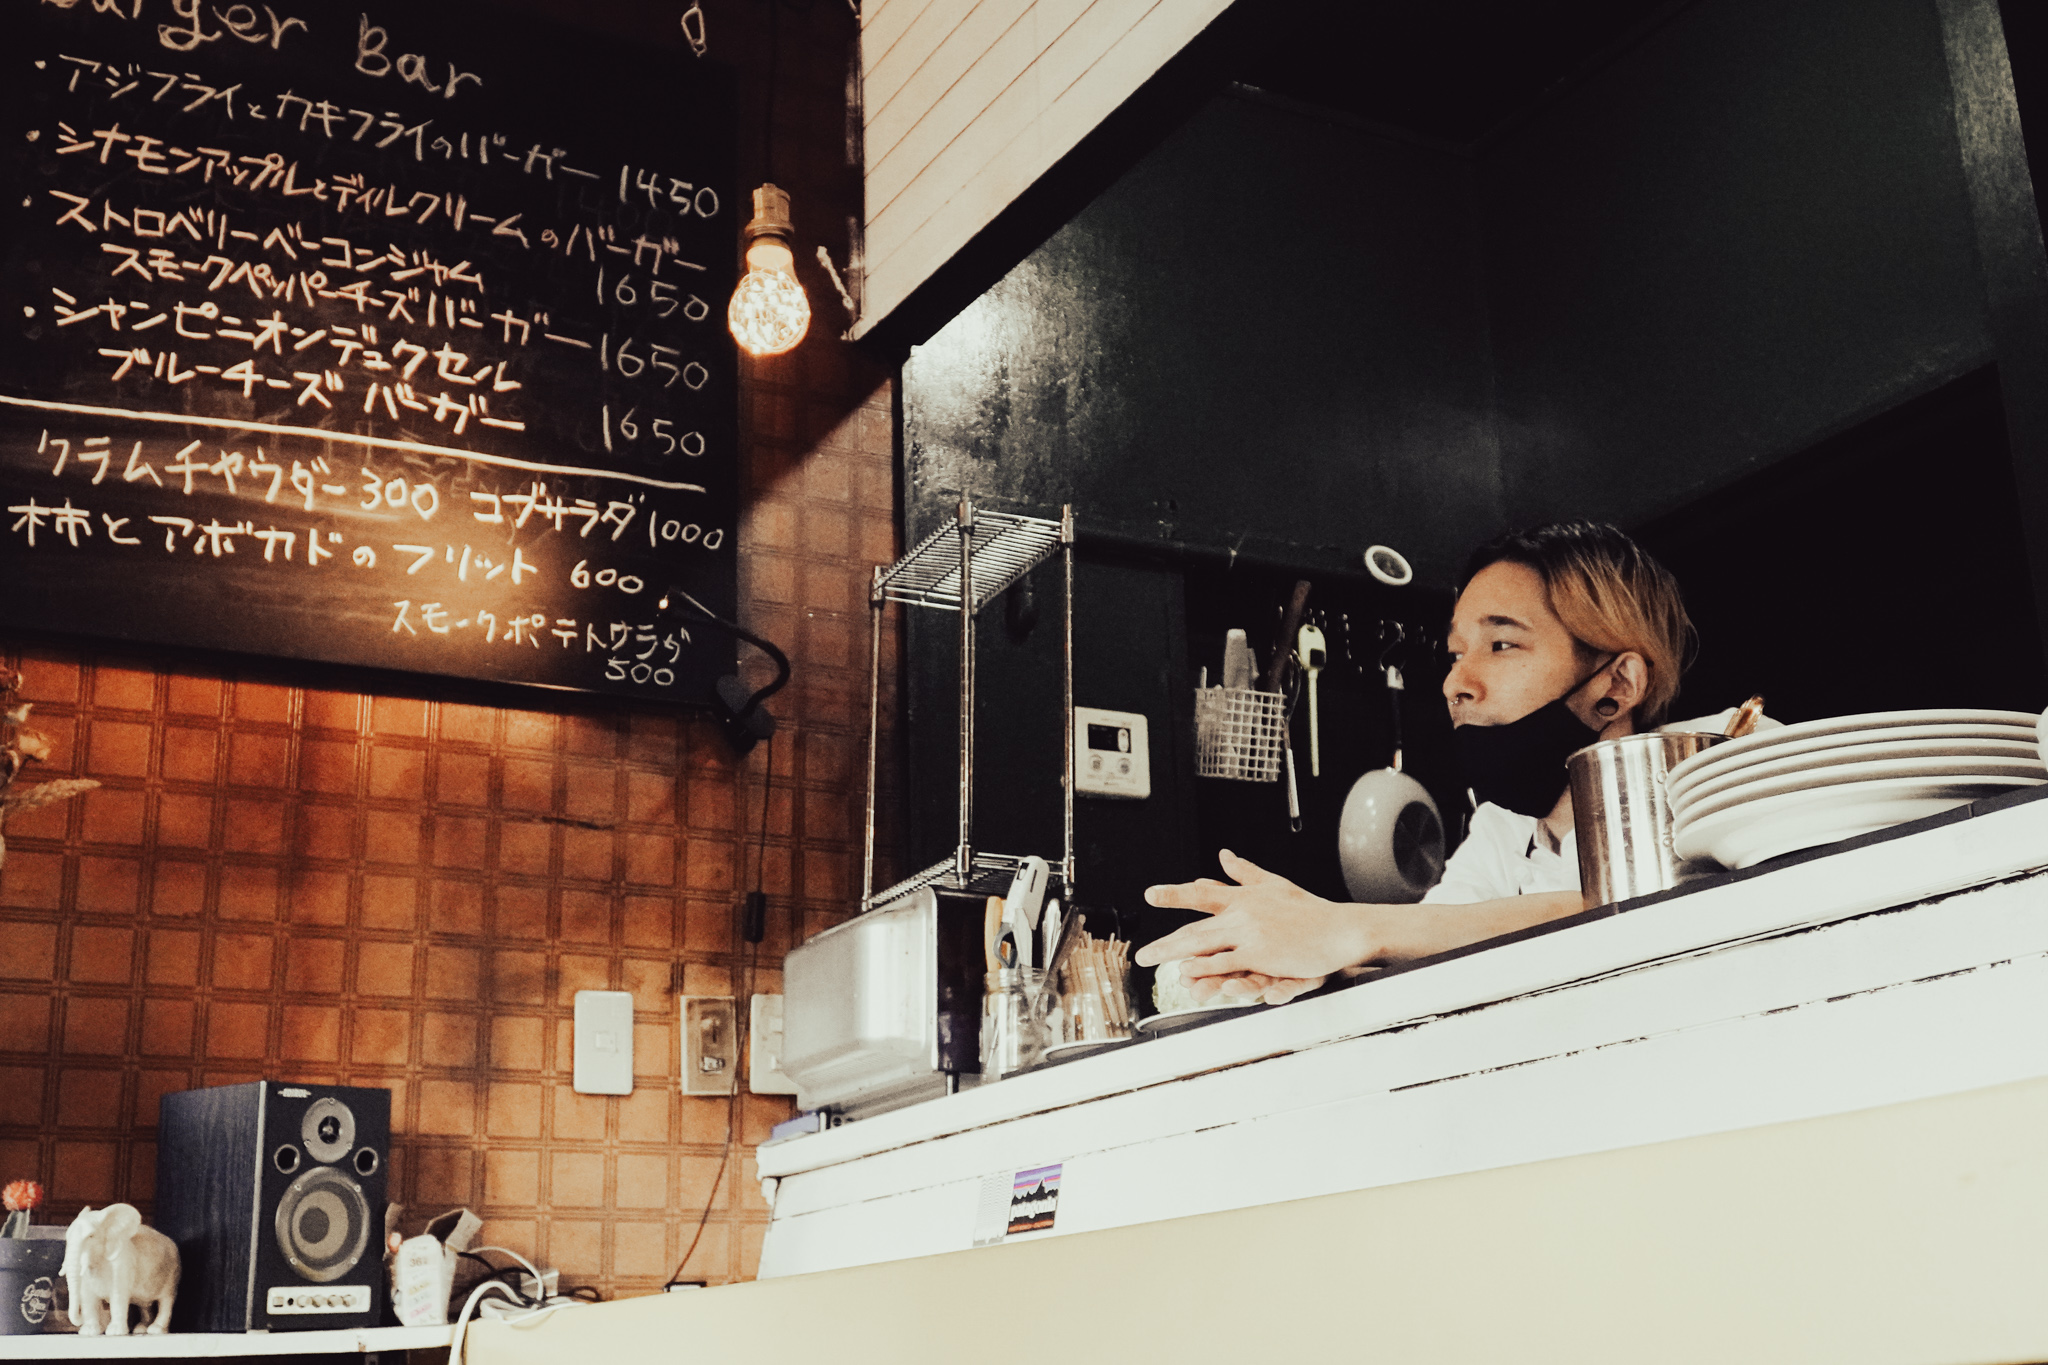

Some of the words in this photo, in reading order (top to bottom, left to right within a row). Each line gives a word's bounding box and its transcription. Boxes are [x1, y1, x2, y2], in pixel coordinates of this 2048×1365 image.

[355, 12, 483, 99] Bar
[619, 164, 720, 219] 1450
[597, 266, 709, 321] 1650
[601, 332, 709, 389] 1650
[603, 405, 706, 457] 1650
[37, 428, 347, 511] クラムチャウダー
[359, 467, 440, 522] 300
[469, 481, 646, 542] コブサラダ
[648, 510, 724, 549] 1000
[570, 559, 645, 594] 600
[605, 655, 675, 686] 500
